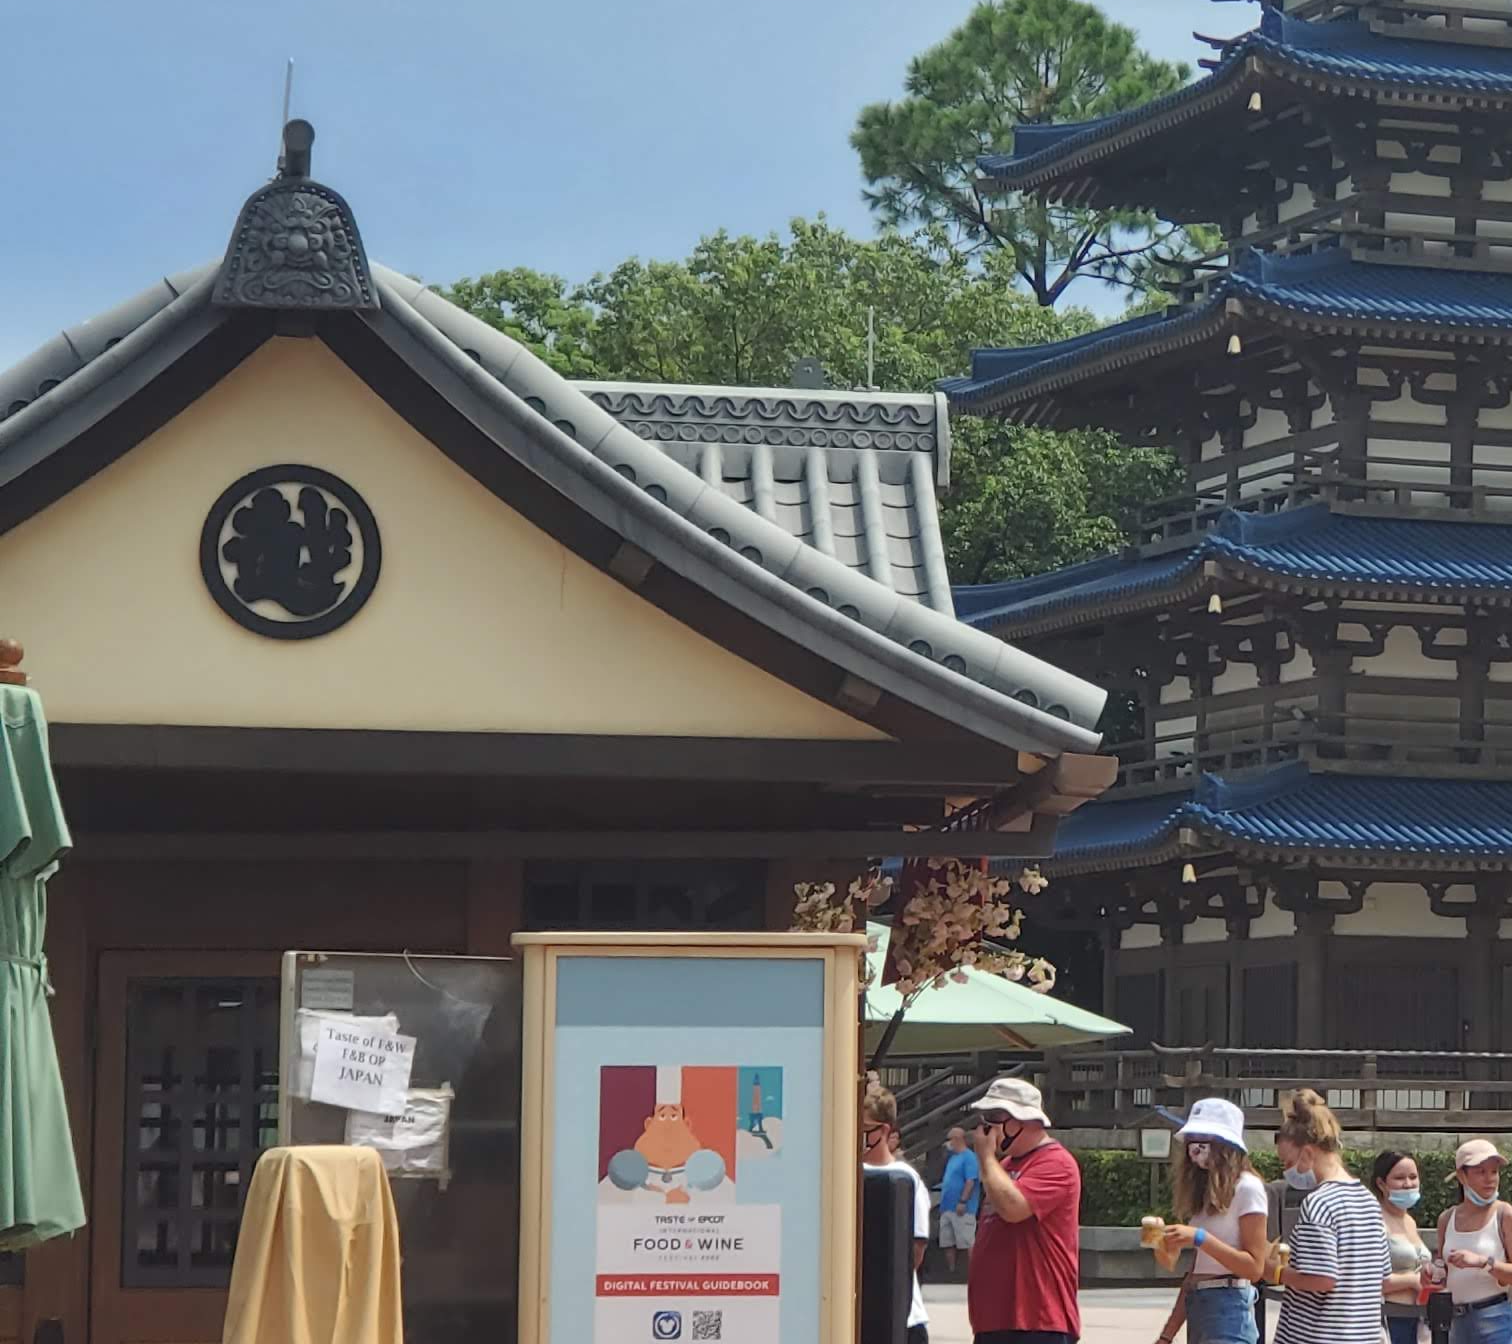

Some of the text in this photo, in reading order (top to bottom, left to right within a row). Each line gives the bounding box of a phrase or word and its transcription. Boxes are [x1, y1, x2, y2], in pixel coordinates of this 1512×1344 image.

[326, 1027, 407, 1054] Taste of F&W
[342, 1048, 365, 1063] F&B
[338, 1066, 384, 1086] JAPAN
[655, 1215, 686, 1224] TASTE
[697, 1215, 726, 1224] EPCOT
[633, 1238, 682, 1251] FOOD
[697, 1237, 745, 1251] WINE
[603, 1279, 770, 1292] DIGITAL FESTIVAL GUIDEBOOK
